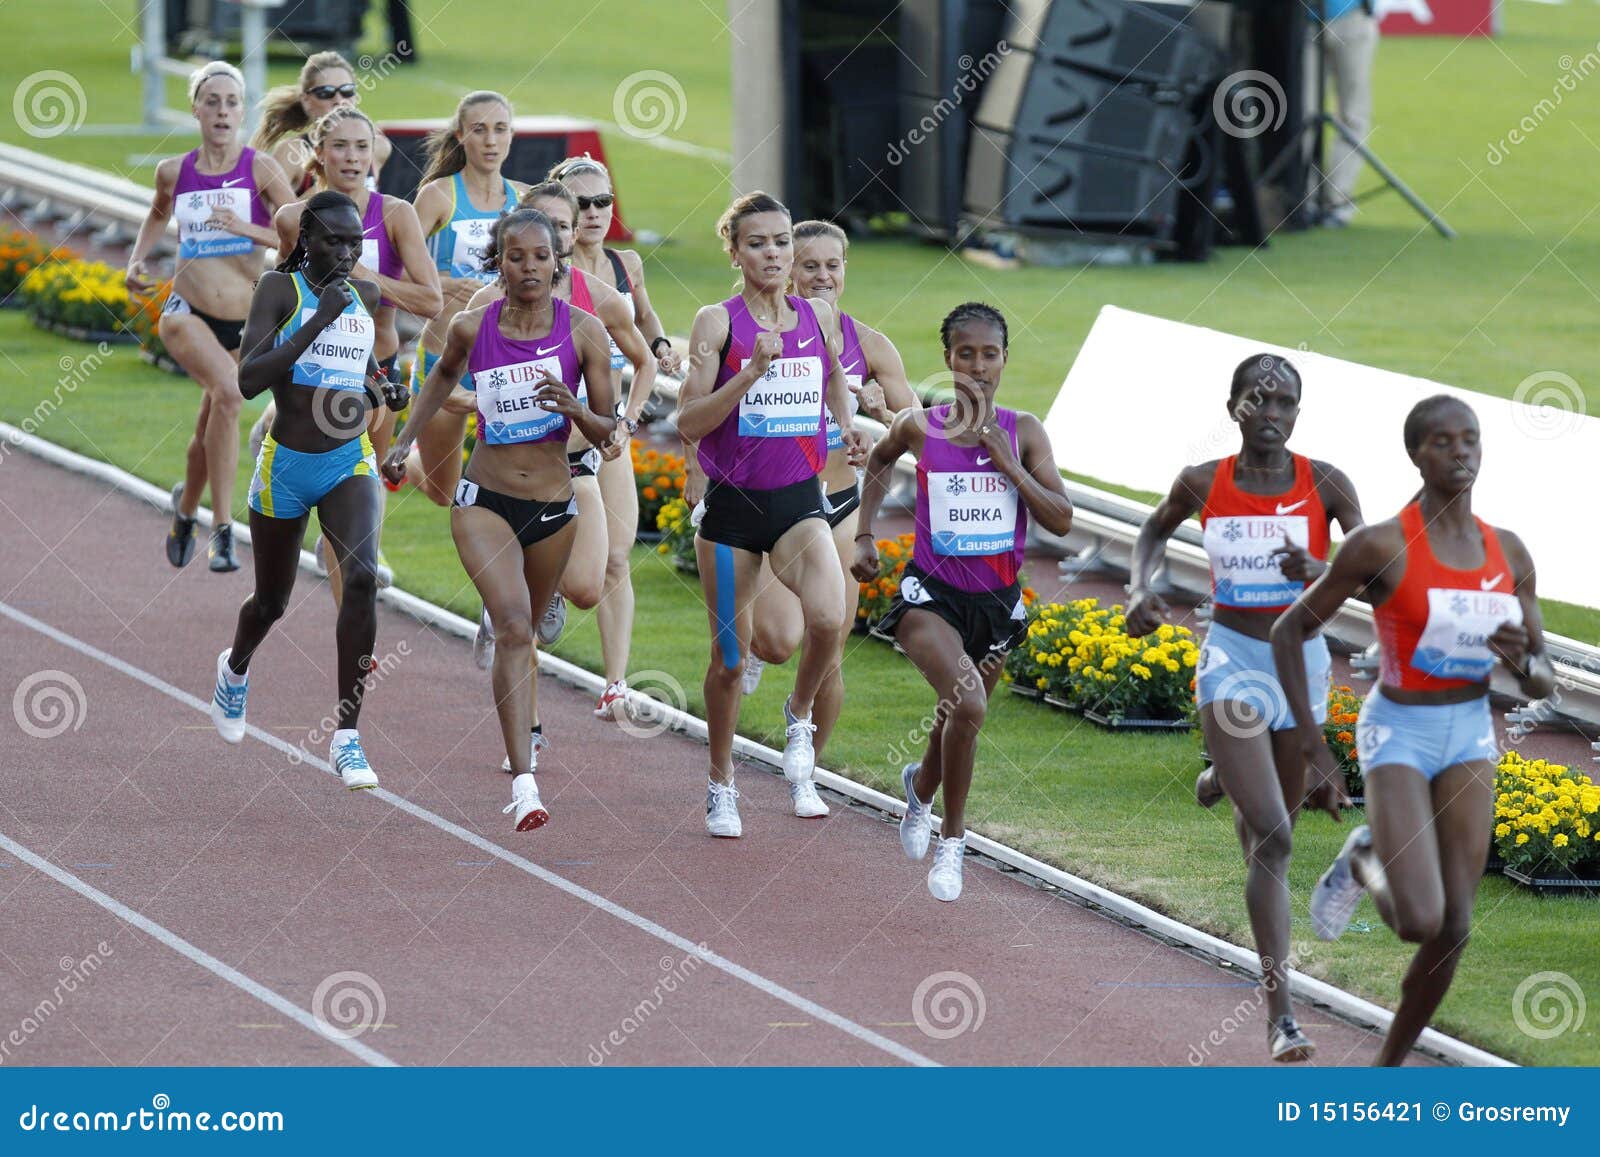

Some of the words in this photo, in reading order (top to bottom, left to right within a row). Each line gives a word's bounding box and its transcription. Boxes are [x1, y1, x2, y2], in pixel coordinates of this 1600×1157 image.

[206, 192, 235, 206] UBS
[340, 316, 365, 334] UBS
[311, 342, 364, 360] KIBIWOT
[510, 364, 545, 383] UBS
[781, 362, 810, 378] UBS
[745, 391, 819, 406] LAKHOUAD
[508, 415, 564, 439] Lausanne
[971, 477, 1008, 493] UBS
[949, 508, 1002, 522] BURKA
[957, 538, 1014, 551] Lausanne
[1221, 556, 1280, 570] LANGA
[909, 580, 921, 601] 3
